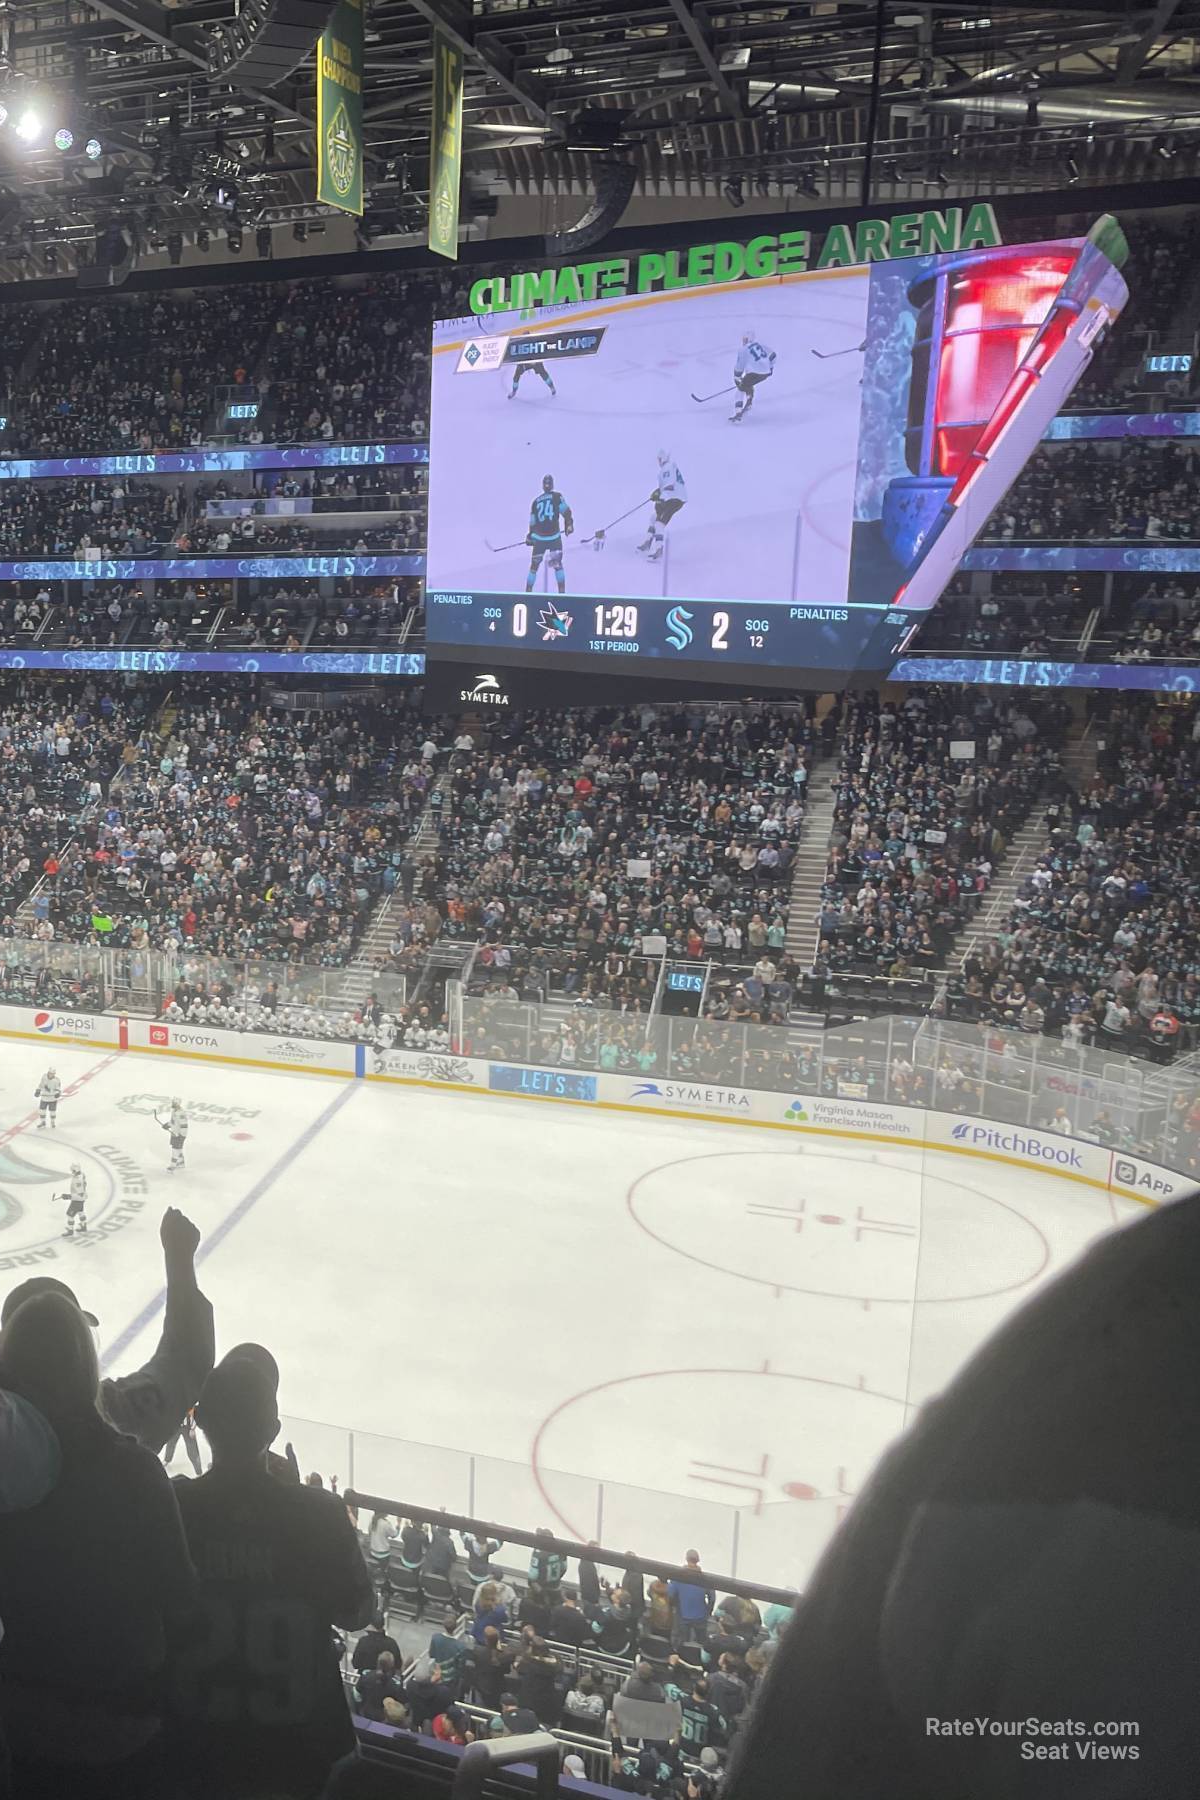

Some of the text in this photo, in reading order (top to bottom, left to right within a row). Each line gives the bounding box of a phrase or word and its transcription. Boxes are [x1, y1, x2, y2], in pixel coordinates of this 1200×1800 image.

[469, 203, 1002, 315] CLIMATE PLEDGE ARENA
[511, 342, 546, 355] LIGHT
[558, 336, 597, 350] LAMP
[535, 500, 554, 522] 24
[433, 595, 473, 605] PENALTIES
[483, 607, 502, 617] SOG
[512, 603, 528, 637] 0
[595, 605, 638, 637] 1:29
[711, 611, 730, 649] 2
[745, 619, 769, 632] SOG
[790, 607, 849, 621] PENALTIES
[489, 622, 763, 653] 4 1ST PERIOD 12
[460, 690, 509, 705] SYMETRA
[57, 1015, 95, 1032] pepsi
[172, 1033, 218, 1047] TOYOTA
[666, 1085, 750, 1106] SYMETRA
[813, 1102, 893, 1120] Virginia Mason
[813, 1112, 910, 1133] Franciscan Health
[973, 1127, 1083, 1168] PitchBook
[91, 1144, 148, 1194] CLIMATE
